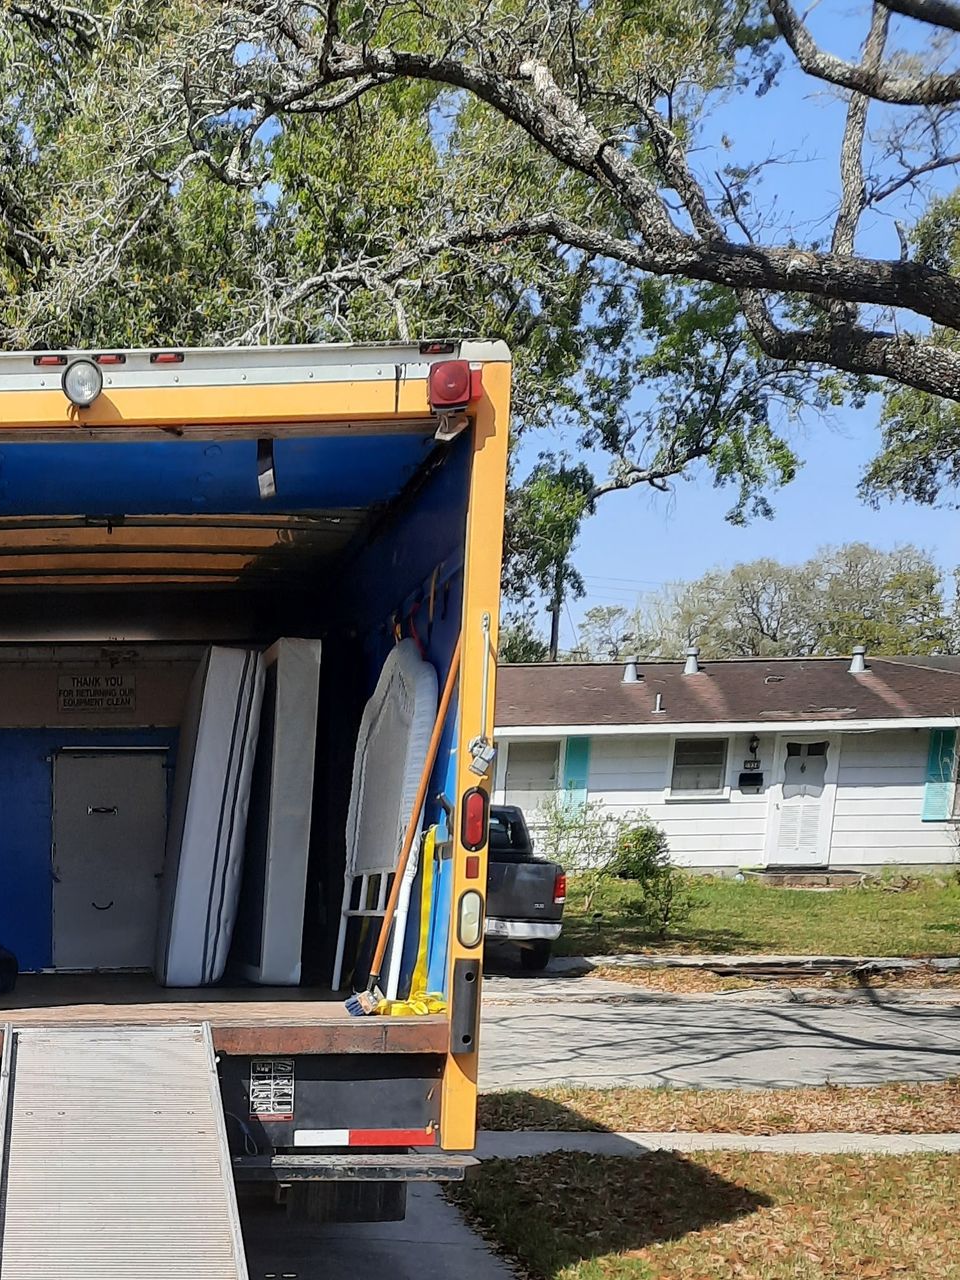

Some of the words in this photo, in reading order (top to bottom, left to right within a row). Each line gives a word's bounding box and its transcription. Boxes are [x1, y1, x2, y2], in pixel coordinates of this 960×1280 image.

[72, 677, 101, 687] THANK
[105, 676, 123, 687] YOU
[58, 688, 74, 697] FOR
[76, 688, 117, 697] RETURNING
[119, 688, 135, 697] OUR
[63, 698, 103, 706] EQUIPMENT
[106, 697, 131, 706] CLEAN
